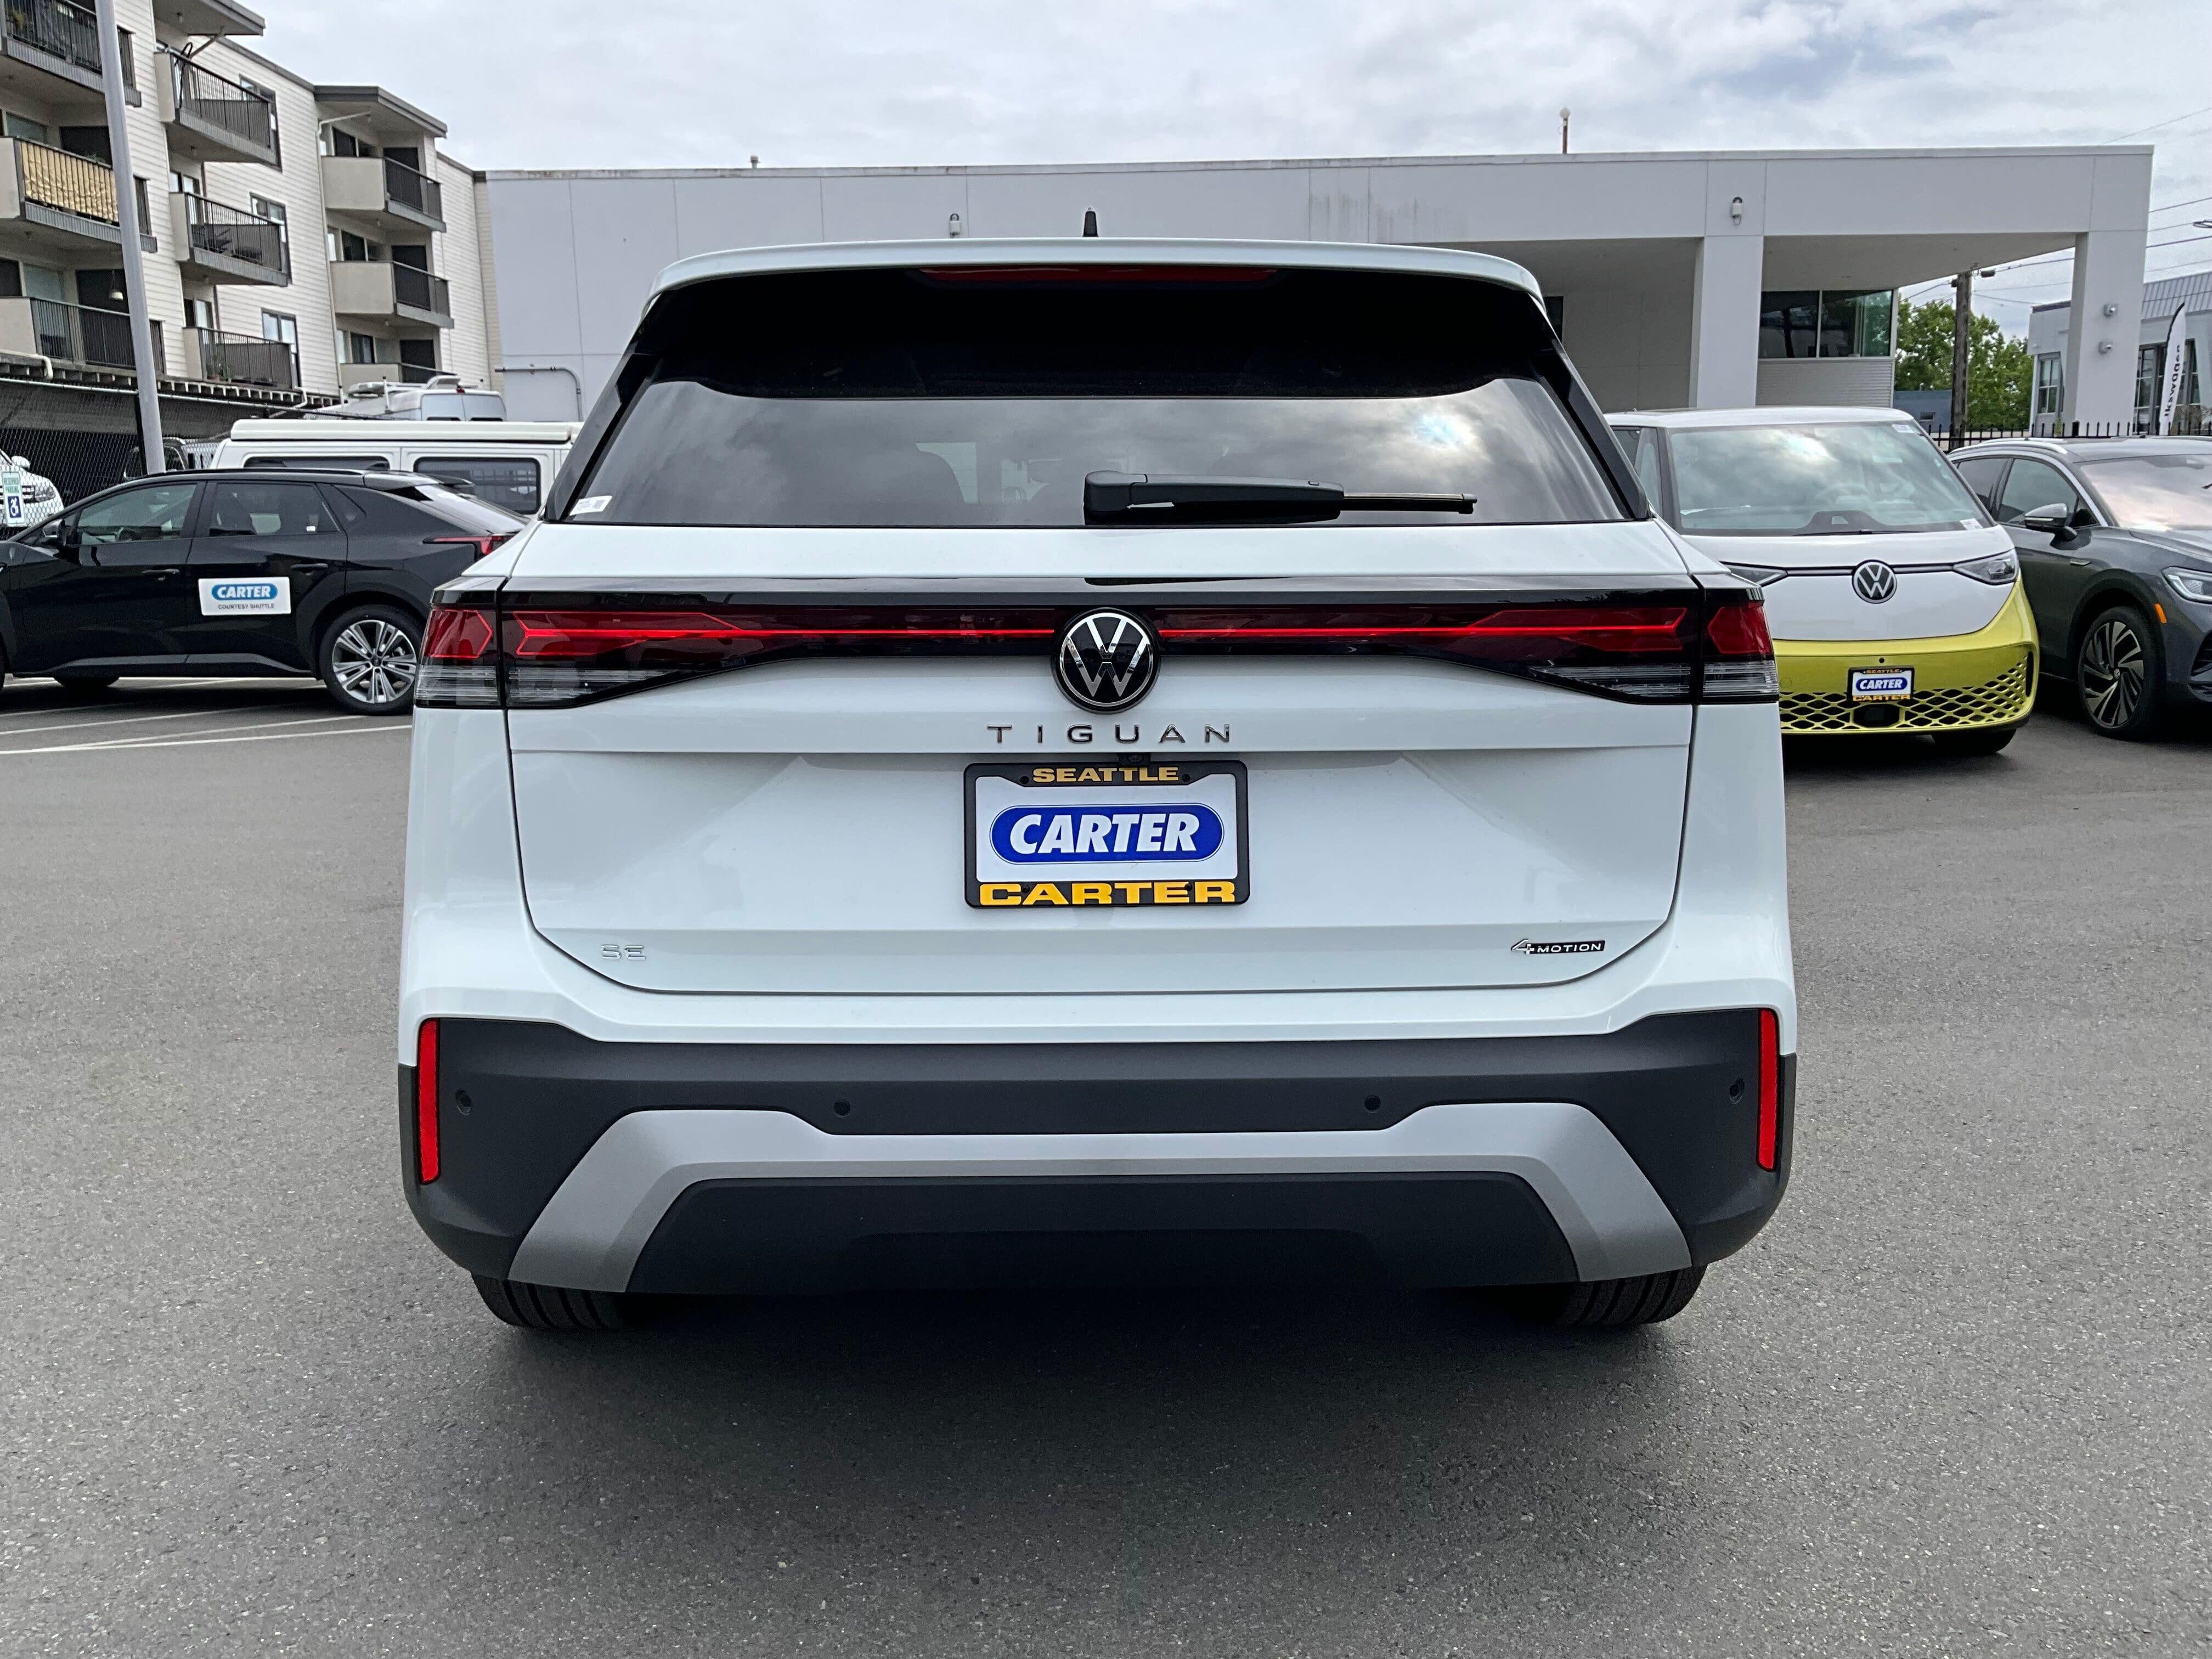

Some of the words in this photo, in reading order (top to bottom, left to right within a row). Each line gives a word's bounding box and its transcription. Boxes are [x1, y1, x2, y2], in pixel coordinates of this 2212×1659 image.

[217, 585, 271, 599] CARTER
[1064, 616, 1152, 700] VW
[1859, 679, 1903, 690] CARTER
[1853, 693, 1910, 702] CARTER
[986, 723, 1232, 744] TIGUAN
[1031, 766, 1180, 783] SEATTLE
[1009, 813, 1200, 855] CARTER
[979, 881, 1236, 906] CARTER
[599, 943, 647, 961] SE
[1511, 938, 1602, 955] 4MOTION
